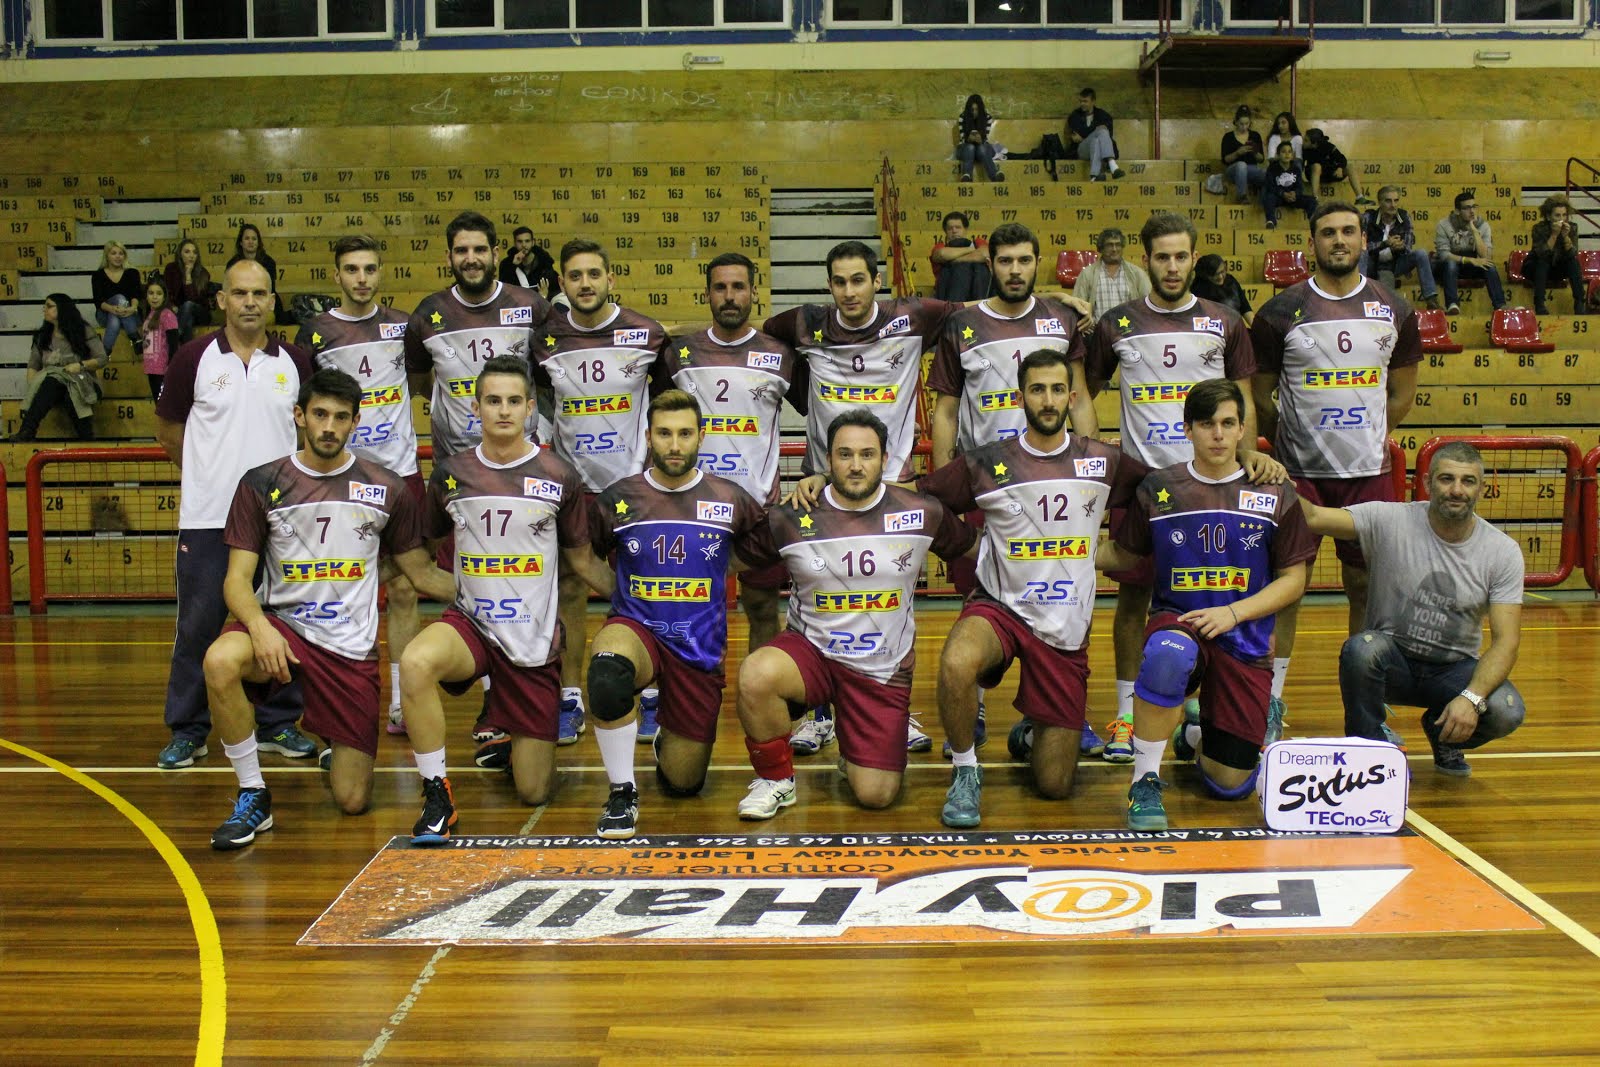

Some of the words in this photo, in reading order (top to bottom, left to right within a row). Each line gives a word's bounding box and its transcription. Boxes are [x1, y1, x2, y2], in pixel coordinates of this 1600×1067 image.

[448, 169, 463, 181] 174
[559, 168, 573, 179] 171
[633, 167, 649, 177] 169
[706, 166, 721, 177] 167
[743, 166, 759, 177] 166
[1129, 164, 1146, 175] 207
[1399, 164, 1415, 175] 201
[1471, 164, 1486, 175] 199
[98, 177, 115, 187] 166
[230, 174, 246, 186] 180
[302, 172, 319, 183] 178
[398, 192, 415, 203] 156
[475, 191, 492, 202] 158
[552, 190, 570, 201] 160
[629, 189, 646, 200] 162
[705, 188, 722, 199] 164
[994, 187, 1010, 197] 184
[1104, 186, 1119, 197] 187
[1495, 188, 1511, 198] 198
[38, 200, 54, 209] 164
[74, 199, 90, 209] 165
[212, 195, 227, 207] 151
[325, 193, 341, 204] 154
[384, 215, 402, 228] 145
[502, 214, 520, 225] 142
[623, 212, 640, 224] 139
[703, 211, 721, 223] 137
[1002, 210, 1018, 221] 177
[1229, 210, 1245, 221] 171
[11, 223, 28, 233] 137
[48, 222, 67, 232] 136
[191, 218, 208, 229] 150
[346, 216, 364, 228] 146
[616, 237, 634, 249] 132
[699, 237, 718, 248] 134
[1050, 234, 1067, 246] 149
[1205, 233, 1223, 245] 153
[1285, 234, 1303, 245] 155
[18, 247, 35, 258] 135
[207, 242, 225, 255] 122
[288, 241, 306, 253] 124
[311, 268, 327, 281] 116
[655, 264, 673, 276] 108
[649, 293, 668, 306] 103
[514, 309, 531, 322] SPI
[892, 317, 909, 332] SPI
[1050, 320, 1063, 331] SP
[1573, 321, 1587, 333] 93
[629, 332, 647, 344] SPI
[1337, 330, 1352, 354] 6
[467, 338, 495, 363] 13
[1162, 344, 1177, 368] 5
[358, 356, 372, 378] 4
[763, 354, 781, 368] SPI
[852, 354, 865, 373] 8
[1430, 355, 1444, 367] 84
[1475, 355, 1489, 367] 85
[1519, 355, 1534, 367] 86
[1565, 355, 1578, 367] 87
[104, 368, 118, 380] 62
[577, 359, 605, 384] 18
[1305, 370, 1379, 386] ETEKA
[360, 389, 402, 405] EKA
[715, 379, 729, 403] 2
[820, 385, 895, 401] ETEKA
[1132, 385, 1190, 401] ETEK
[1416, 393, 1431, 406] 62
[1464, 393, 1477, 405] 61
[1511, 393, 1526, 405] 60
[1556, 393, 1571, 405] 59
[562, 397, 630, 414] ETEKA
[118, 406, 134, 419] 58
[1320, 407, 1366, 426] RS
[701, 418, 758, 433] TEKA
[351, 422, 394, 444] RS
[575, 432, 618, 451] RS
[1400, 437, 1416, 450] 46
[698, 453, 742, 471] RS
[1089, 460, 1105, 471] SPI
[365, 487, 385, 500] SPI
[541, 482, 561, 496] SPI
[1538, 484, 1555, 498] 25
[46, 497, 63, 511] 28
[158, 496, 176, 510] 26
[1037, 493, 1068, 522] 12
[1256, 495, 1274, 508] SPI
[713, 505, 732, 518] SPI
[480, 508, 513, 537] 17
[901, 512, 922, 525] SPI
[316, 516, 331, 544] 7
[1197, 523, 1226, 553] 10
[652, 534, 686, 564] 14
[1009, 539, 1088, 557] ETEKA
[1528, 538, 1540, 553] 11
[64, 549, 73, 564] 4
[123, 549, 132, 564] 5
[461, 557, 540, 574] ETEKA
[841, 549, 876, 577] 16
[282, 562, 363, 580] ETEKA
[1173, 571, 1246, 588] ETEKA
[631, 580, 708, 598] ETEKA
[1022, 580, 1074, 601] RS
[816, 593, 899, 610] ETEKA
[293, 601, 344, 620] RS
[474, 598, 522, 619] RS
[1413, 606, 1448, 628] YOUR
[827, 631, 883, 651] RS
[696, 837, 748, 846] 244
[757, 837, 790, 846] 23
[799, 837, 833, 846] 46
[842, 836, 892, 845] 210
[631, 850, 755, 861] Laptop
[1040, 846, 1177, 857] Service
[539, 865, 654, 876] store
[673, 863, 895, 875] computer
[480, 886, 862, 928] Hall
